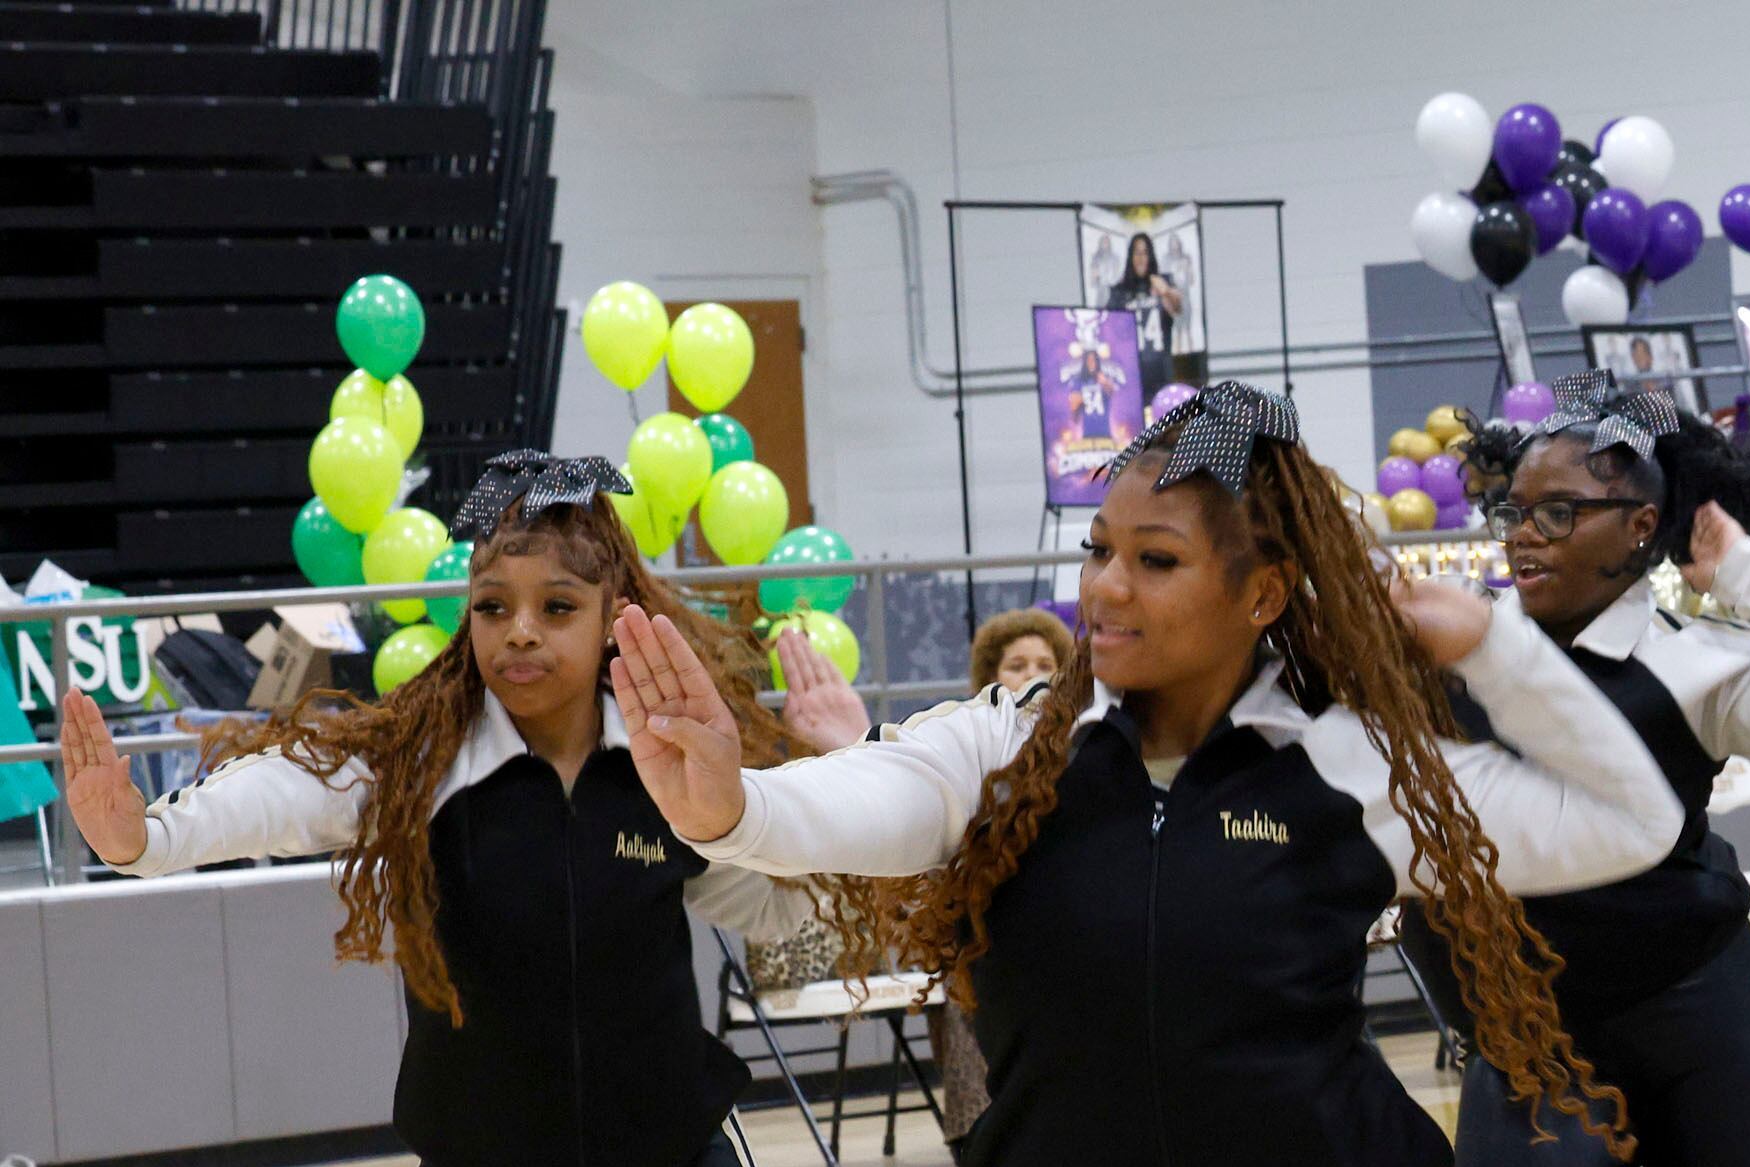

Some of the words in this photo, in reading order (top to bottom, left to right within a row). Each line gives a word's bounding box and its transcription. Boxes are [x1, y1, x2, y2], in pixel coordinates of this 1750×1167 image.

[17, 616, 151, 711] NSU
[1219, 809, 1290, 845] Taahira
[615, 830, 667, 868] Aaliyah
